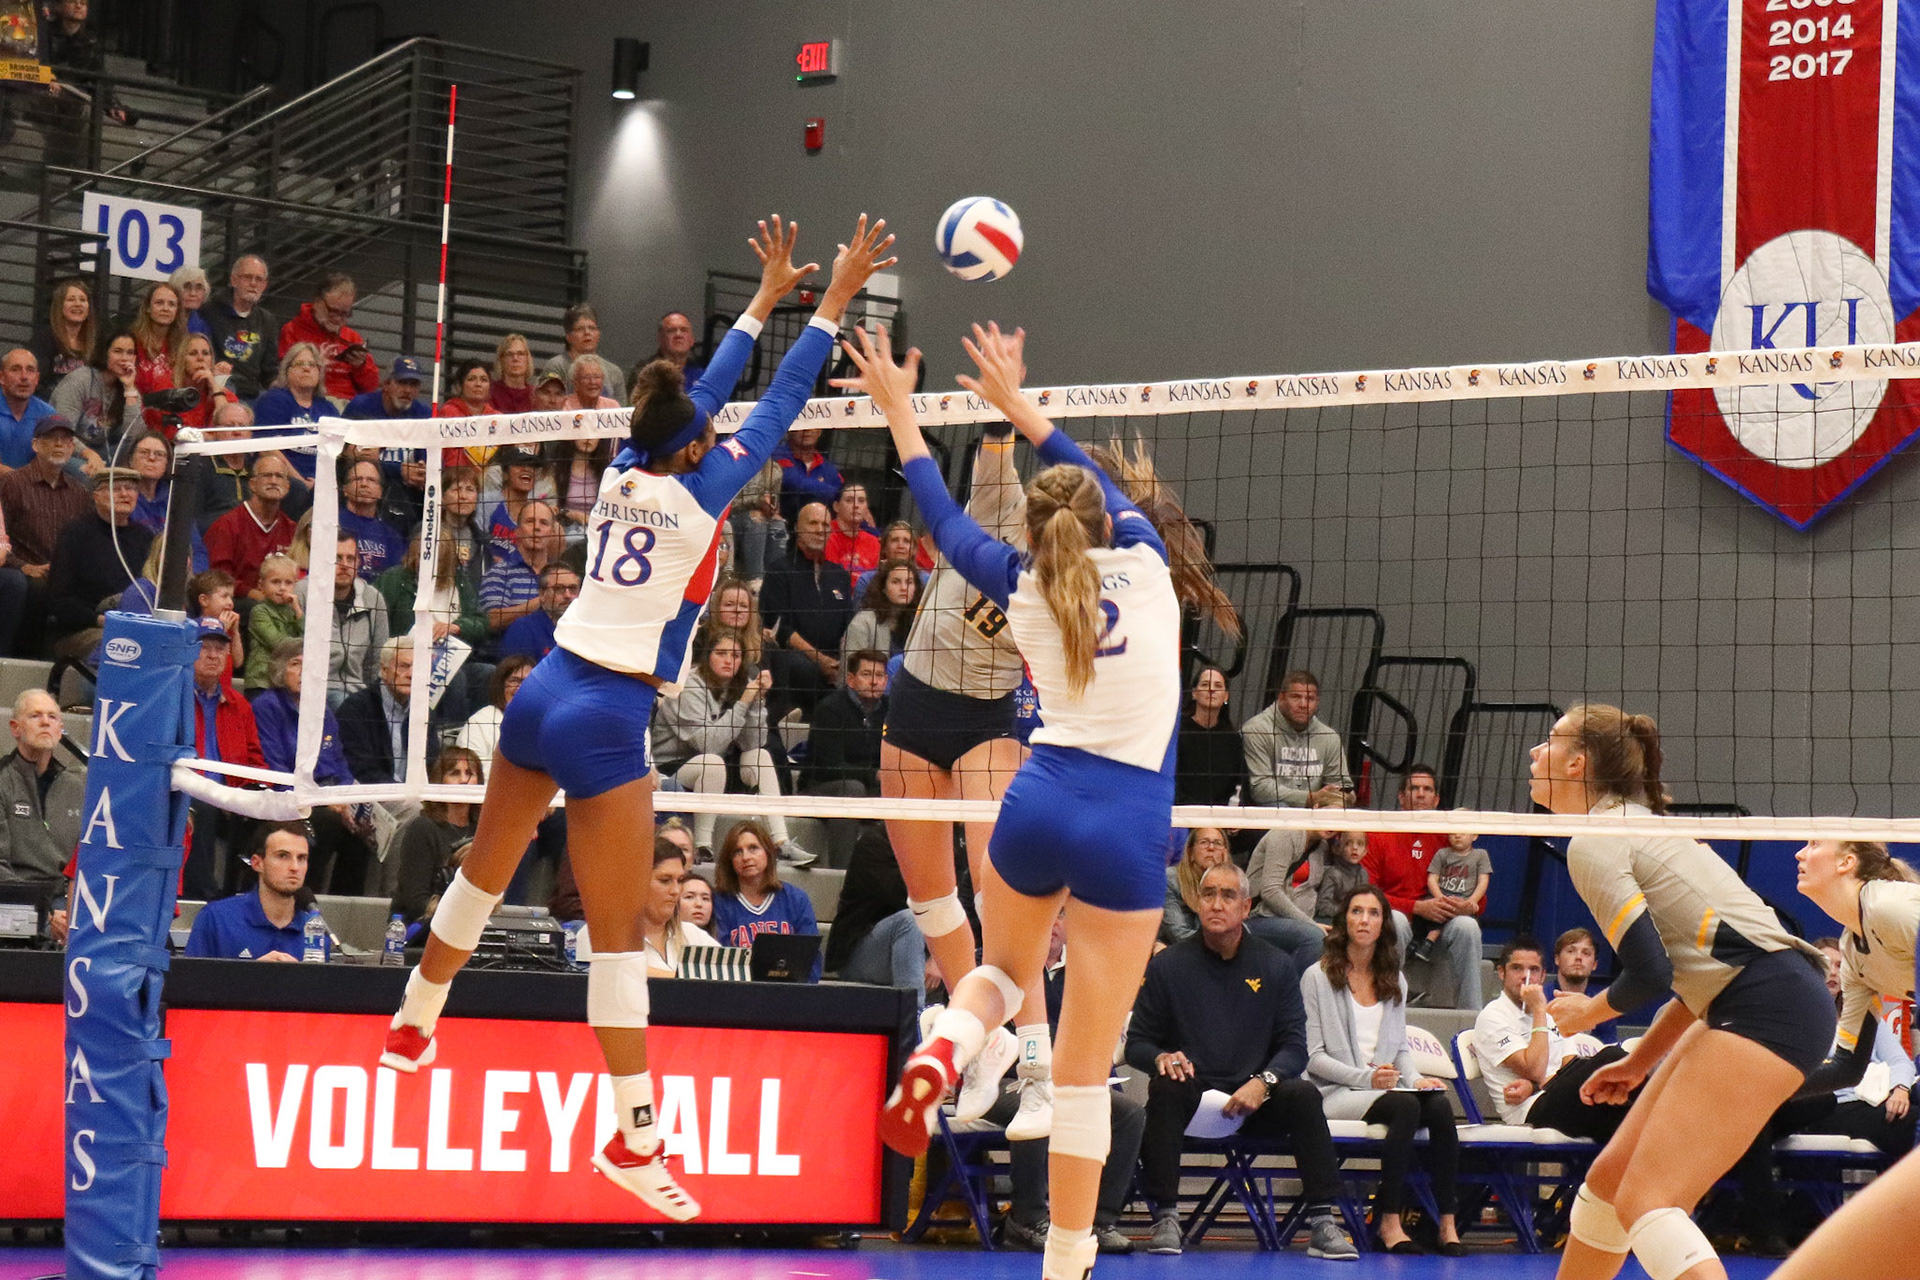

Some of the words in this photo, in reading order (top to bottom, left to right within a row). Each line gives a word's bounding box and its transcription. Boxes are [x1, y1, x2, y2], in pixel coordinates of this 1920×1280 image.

[800, 42, 829, 72] EXIT
[1768, 14, 1855, 47] 2014
[1768, 49, 1854, 82] 2017
[98, 203, 185, 274] 103
[509, 414, 562, 435] KANSAS
[596, 411, 632, 430] KANS
[1065, 386, 1128, 407] KANSAS
[1168, 380, 1232, 403] KANSAS
[1275, 376, 1340, 398] KANSAS
[1384, 370, 1452, 393] KANSAS
[1497, 364, 1567, 387] KANSAS
[1616, 358, 1690, 381] KANSAS
[1738, 352, 1813, 375] KANSAS
[1862, 345, 1920, 369] KANSA
[423, 500, 436, 561] Schelde
[589, 519, 657, 587] 18
[963, 593, 1009, 640] 19
[107, 642, 138, 655] SNA
[64, 697, 138, 1192] KANSAS
[245, 1062, 801, 1177] VOLLEYALL
